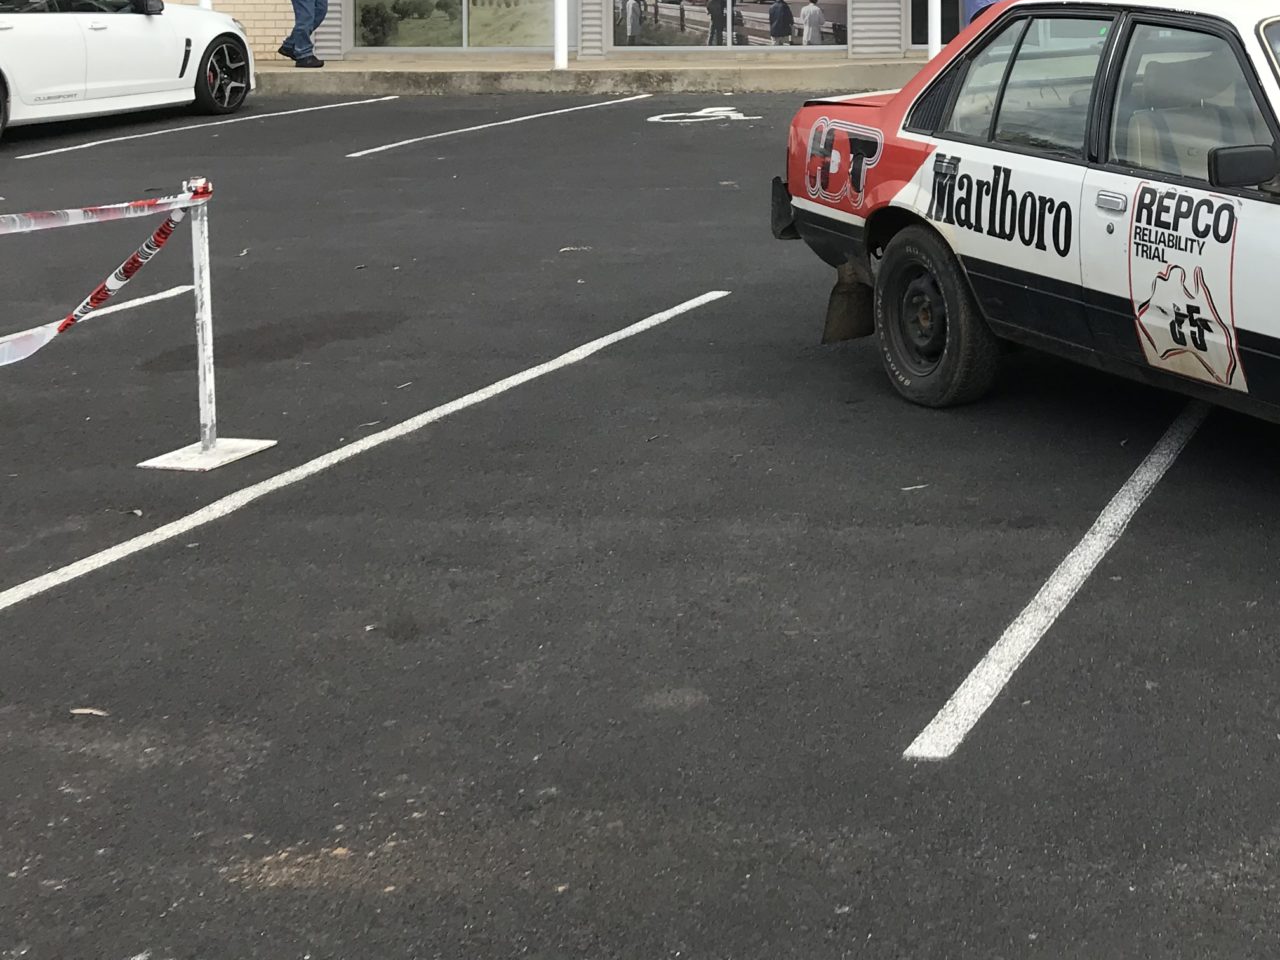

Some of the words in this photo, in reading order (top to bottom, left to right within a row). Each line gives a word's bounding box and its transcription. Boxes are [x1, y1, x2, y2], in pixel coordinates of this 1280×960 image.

[926, 153, 1072, 257] Marlboro
[1135, 186, 1236, 244] REPCO
[1133, 225, 1206, 255] RELIABILITY
[1133, 241, 1169, 263] TRIAL
